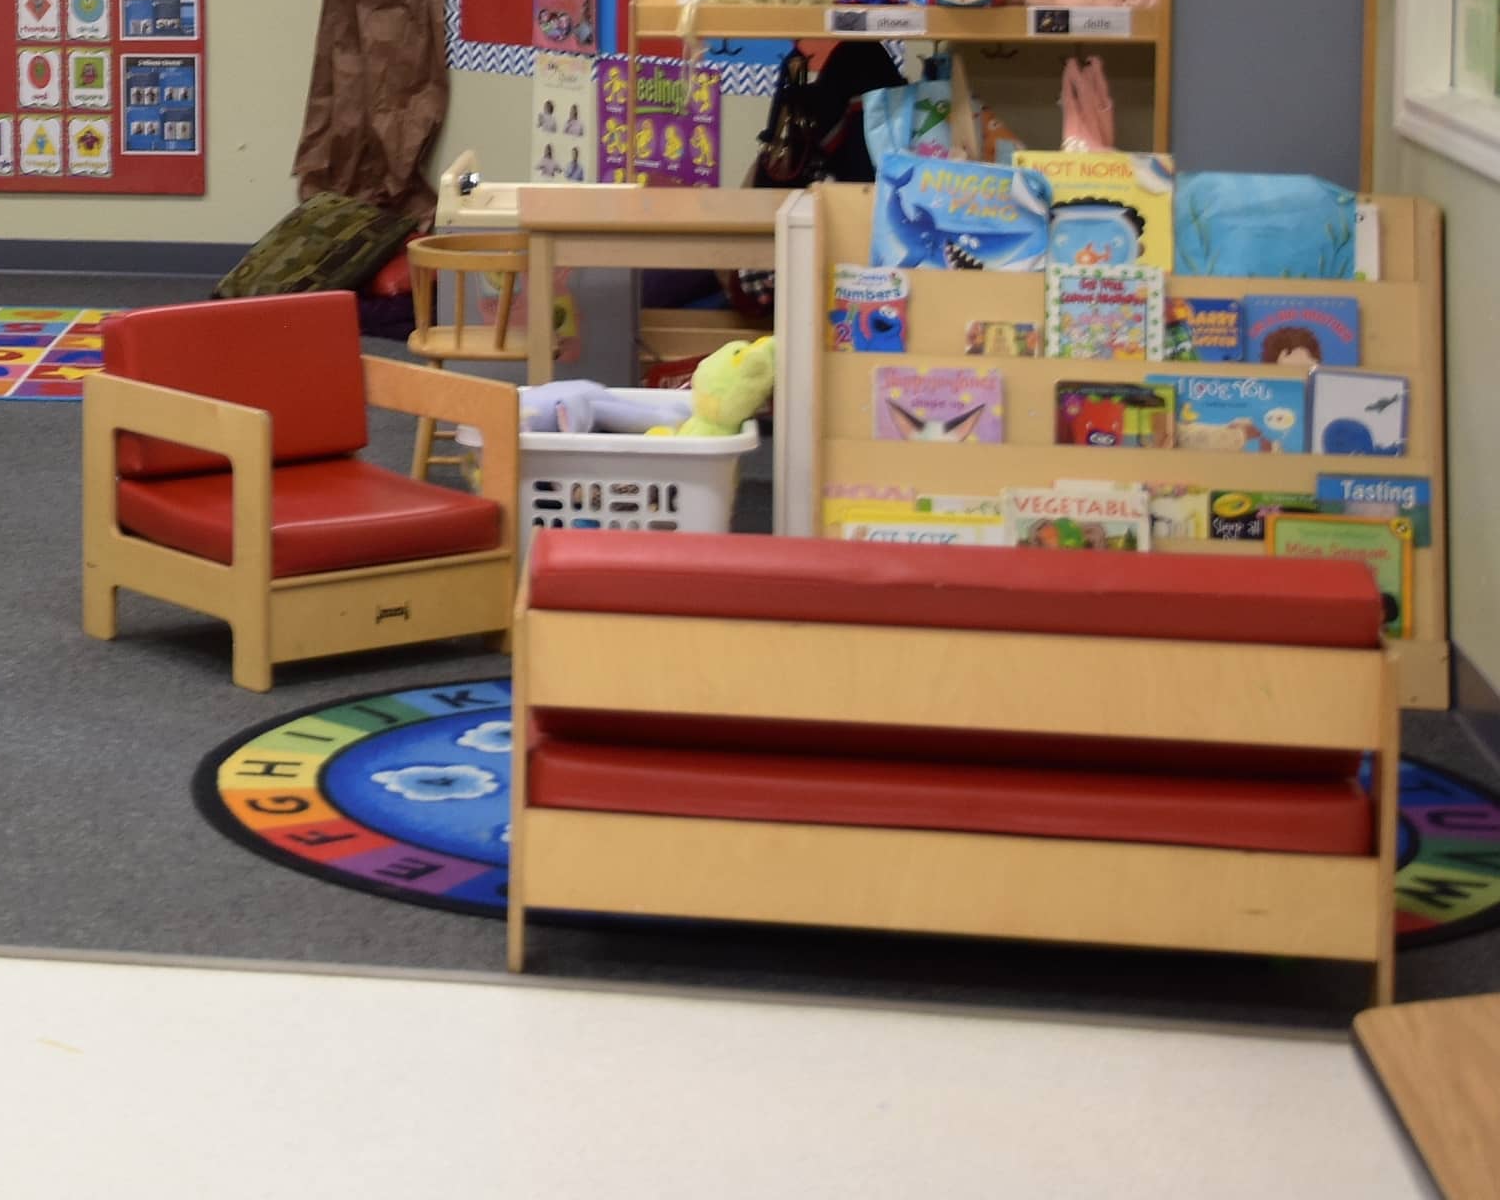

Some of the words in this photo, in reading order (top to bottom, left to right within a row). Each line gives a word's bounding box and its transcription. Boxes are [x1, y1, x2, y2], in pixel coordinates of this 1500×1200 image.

[636, 66, 691, 116] eeling
[919, 168, 1013, 199] NUGGE
[835, 286, 901, 300] numbers
[1340, 479, 1417, 509] Tasting
[236, 759, 304, 778] H
[247, 795, 312, 815] G
[285, 829, 361, 847] F
[372, 857, 446, 882] E
